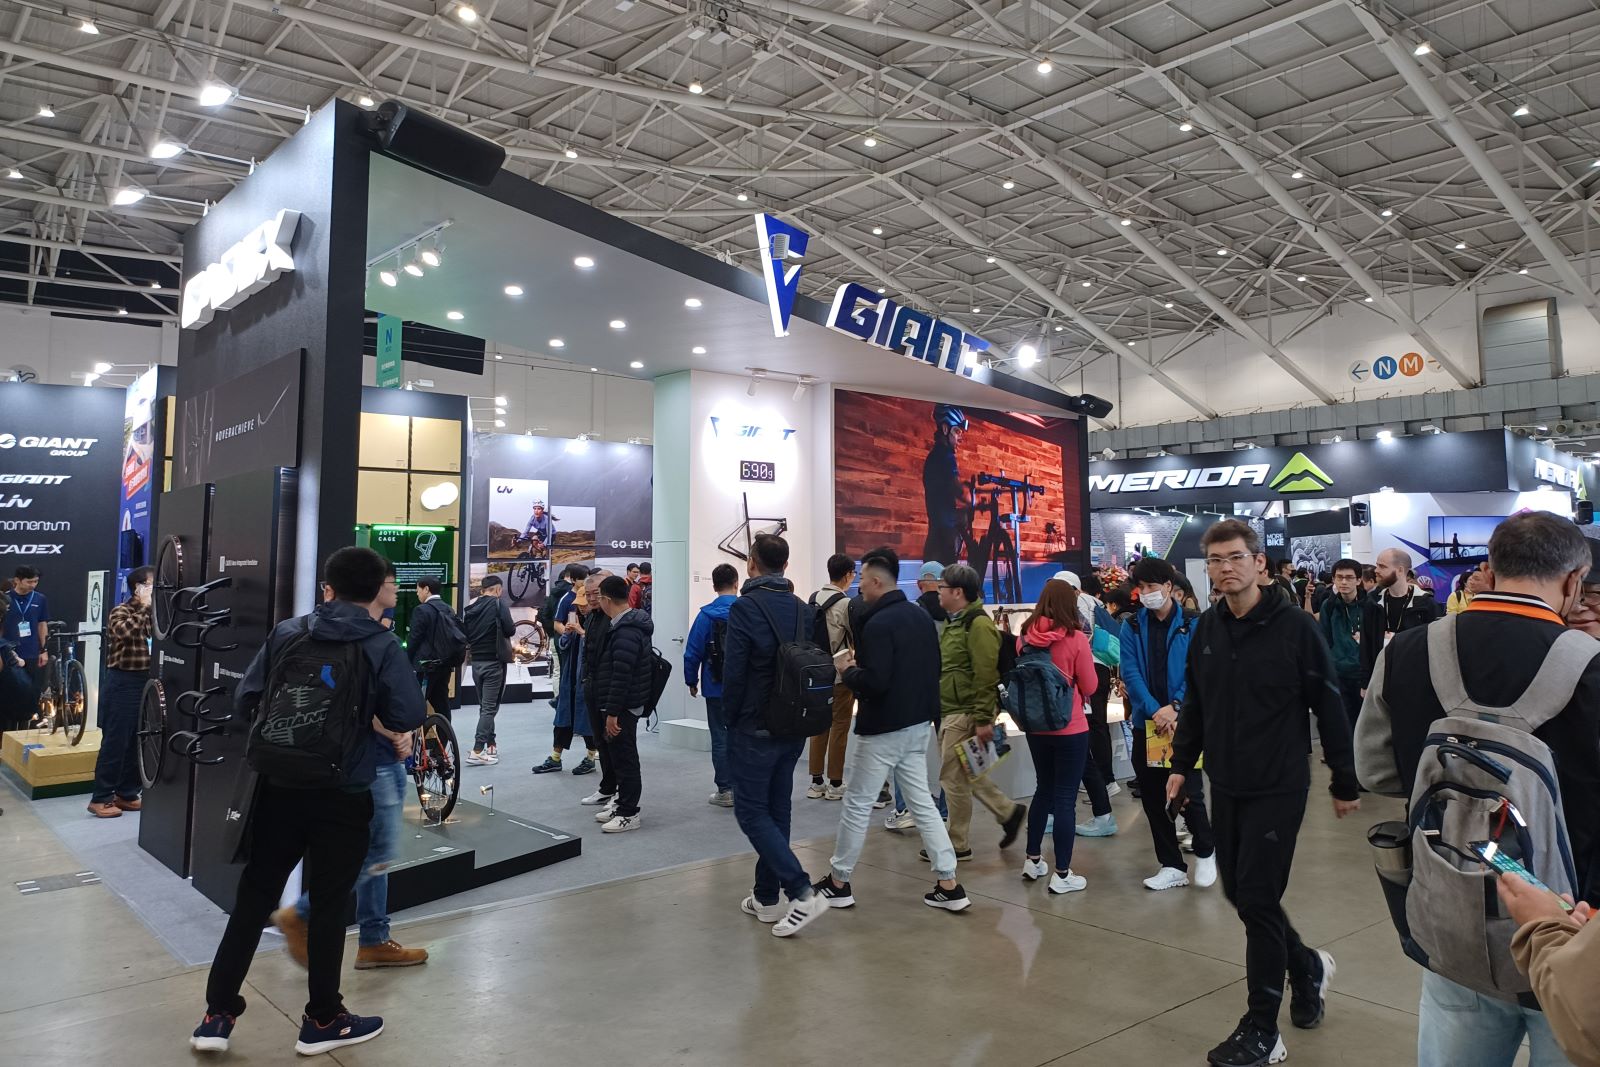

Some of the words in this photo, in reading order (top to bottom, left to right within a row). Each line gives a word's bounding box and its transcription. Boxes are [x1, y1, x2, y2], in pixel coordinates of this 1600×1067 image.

[826, 283, 992, 378] GIANT
[1378, 360, 1391, 376] N
[1403, 356, 1419, 373] M
[19, 436, 98, 449] GIANT
[1089, 463, 1271, 493] MERIDA
[611, 540, 626, 548] GO
[630, 540, 652, 549] BEY
